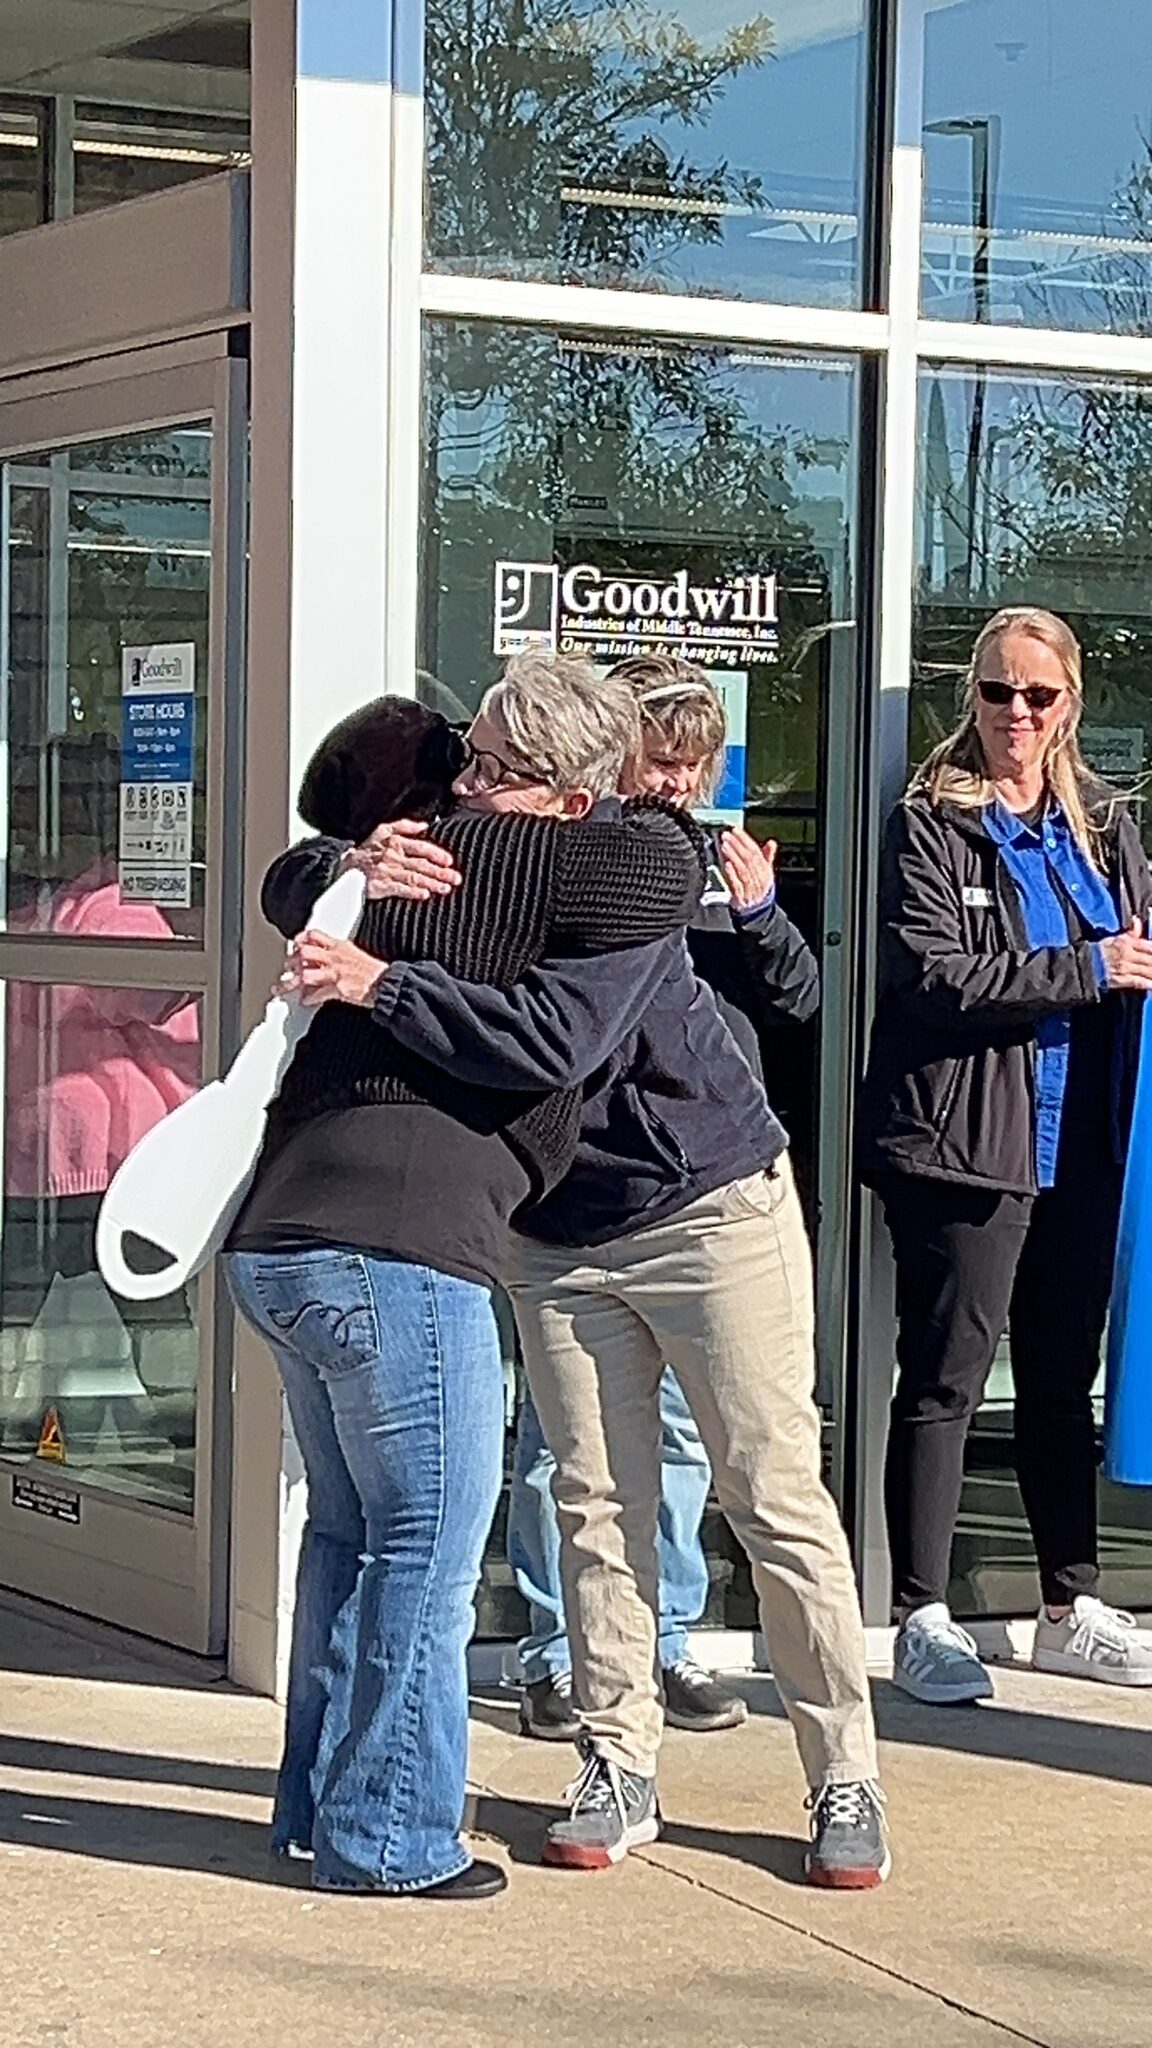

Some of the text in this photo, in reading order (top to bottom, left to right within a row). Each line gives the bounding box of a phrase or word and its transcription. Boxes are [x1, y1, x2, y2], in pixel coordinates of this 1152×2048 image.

[561, 565, 779, 623] Goodwill
[561, 614, 625, 631] Industries
[627, 618, 641, 632] of
[641, 618, 686, 635] Middle
[560, 637, 592, 652] Our
[595, 641, 651, 656] mission
[655, 642, 668, 656] is
[671, 641, 737, 666] changing
[740, 645, 778, 664] lives.
[142, 657, 182, 678] Goodwill
[129, 702, 186, 720] STORE HOURS
